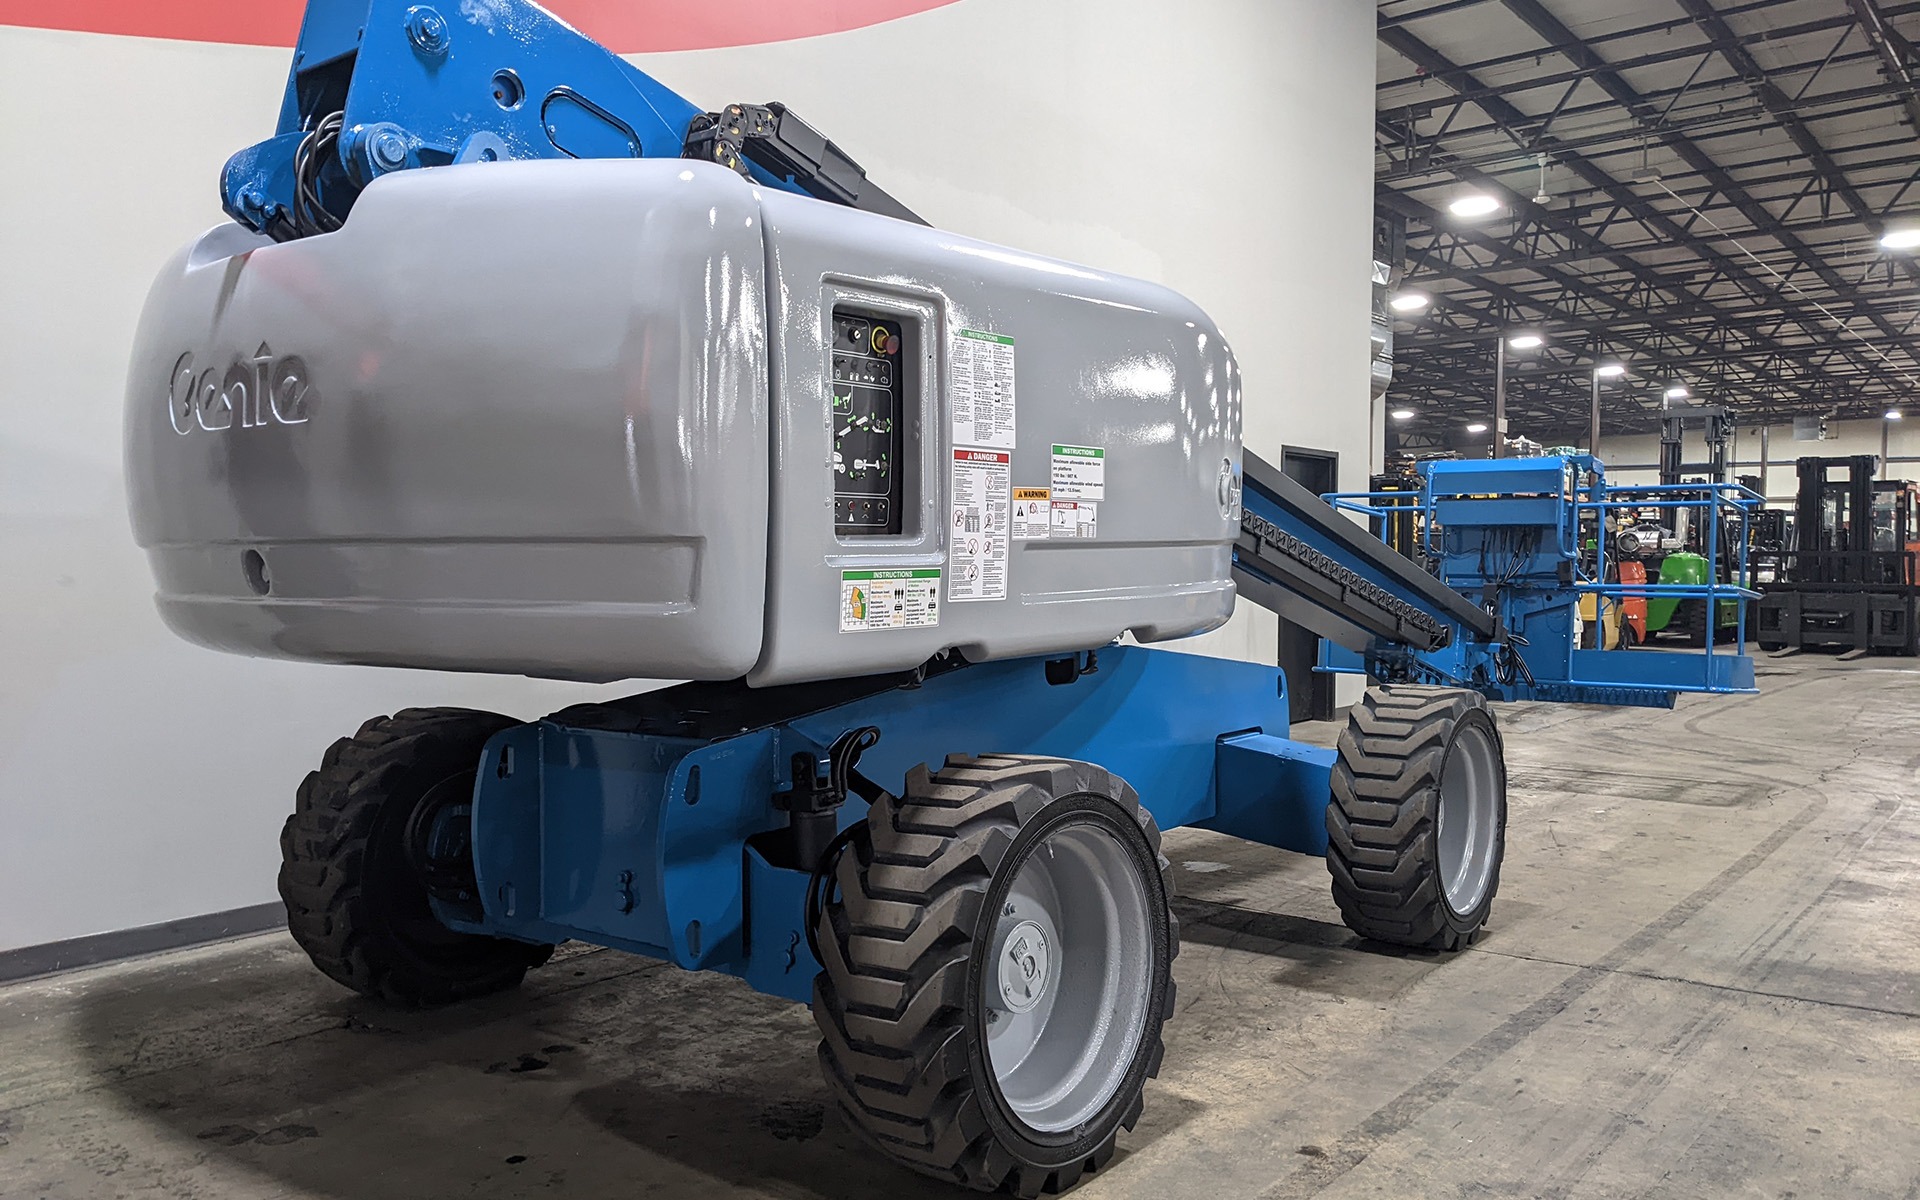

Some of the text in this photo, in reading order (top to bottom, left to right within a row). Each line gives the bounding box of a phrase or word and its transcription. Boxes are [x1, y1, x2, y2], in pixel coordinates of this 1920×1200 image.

[168, 340, 310, 437] Genie
[973, 452, 998, 462] DANGER
[1062, 447, 1095, 457] INSTRUCTIONS
[1022, 490, 1047, 499] WARNING
[873, 570, 913, 578] INSTRUCTIONS
